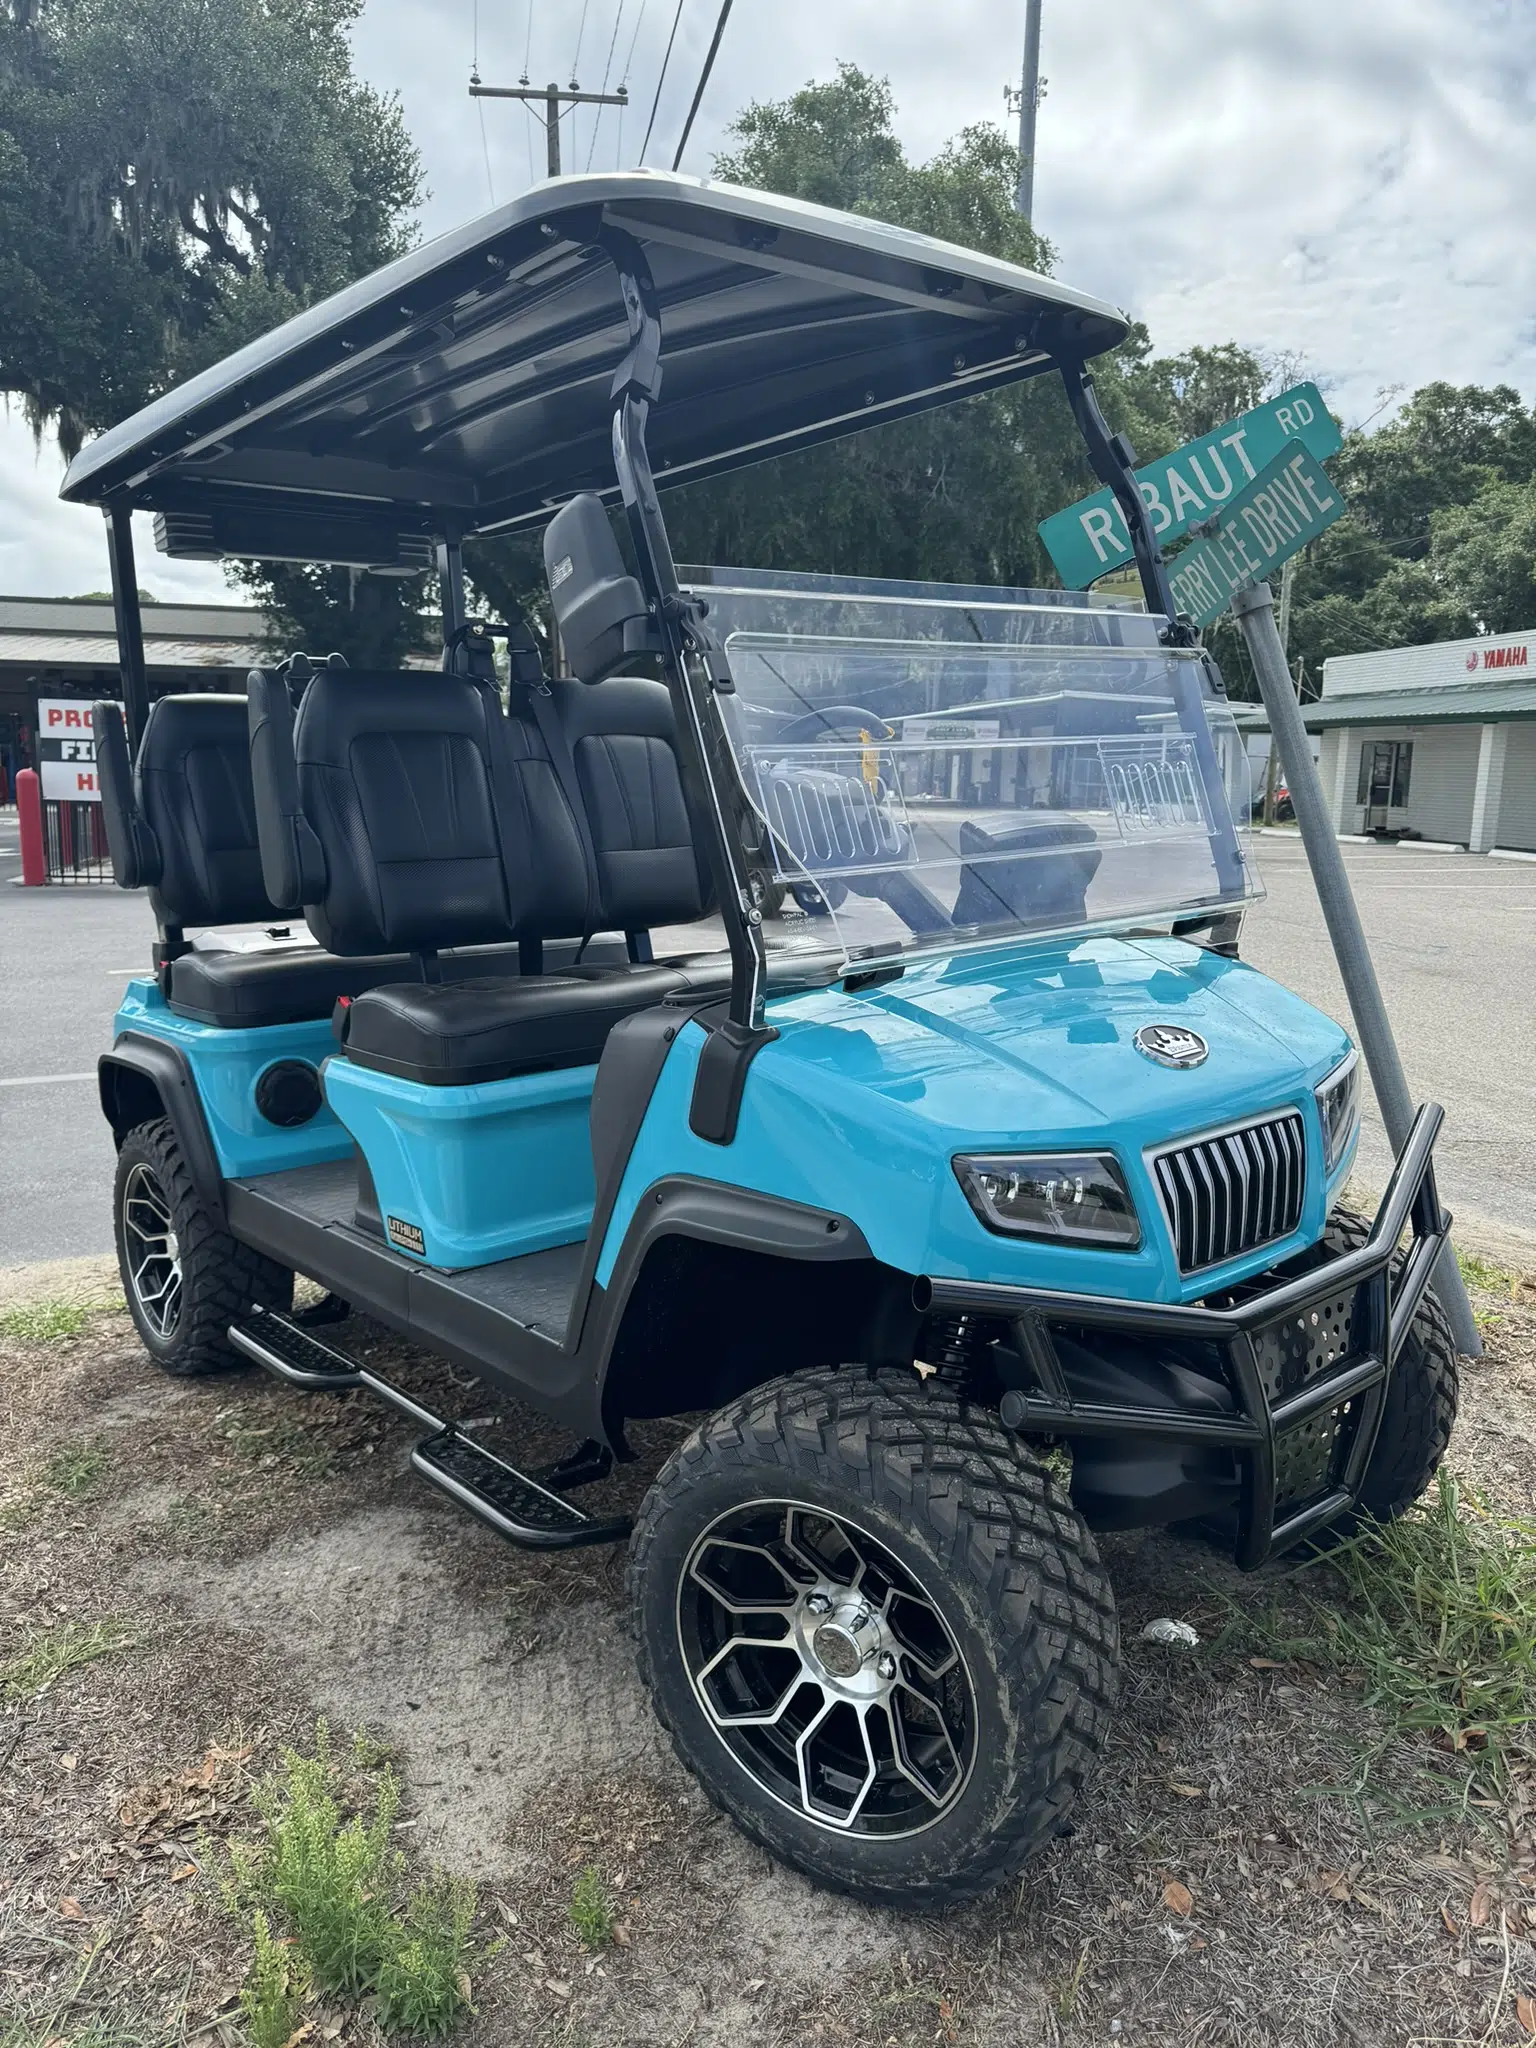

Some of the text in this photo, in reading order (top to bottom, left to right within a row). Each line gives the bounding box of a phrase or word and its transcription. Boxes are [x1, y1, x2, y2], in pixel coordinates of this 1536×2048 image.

[1079, 399, 1314, 563] RIBAUT RD
[1169, 454, 1335, 623] ERRY LEE DRIVE
[1484, 646, 1527, 669] YAMAHA
[388, 1217, 423, 1242] LITHIUM
